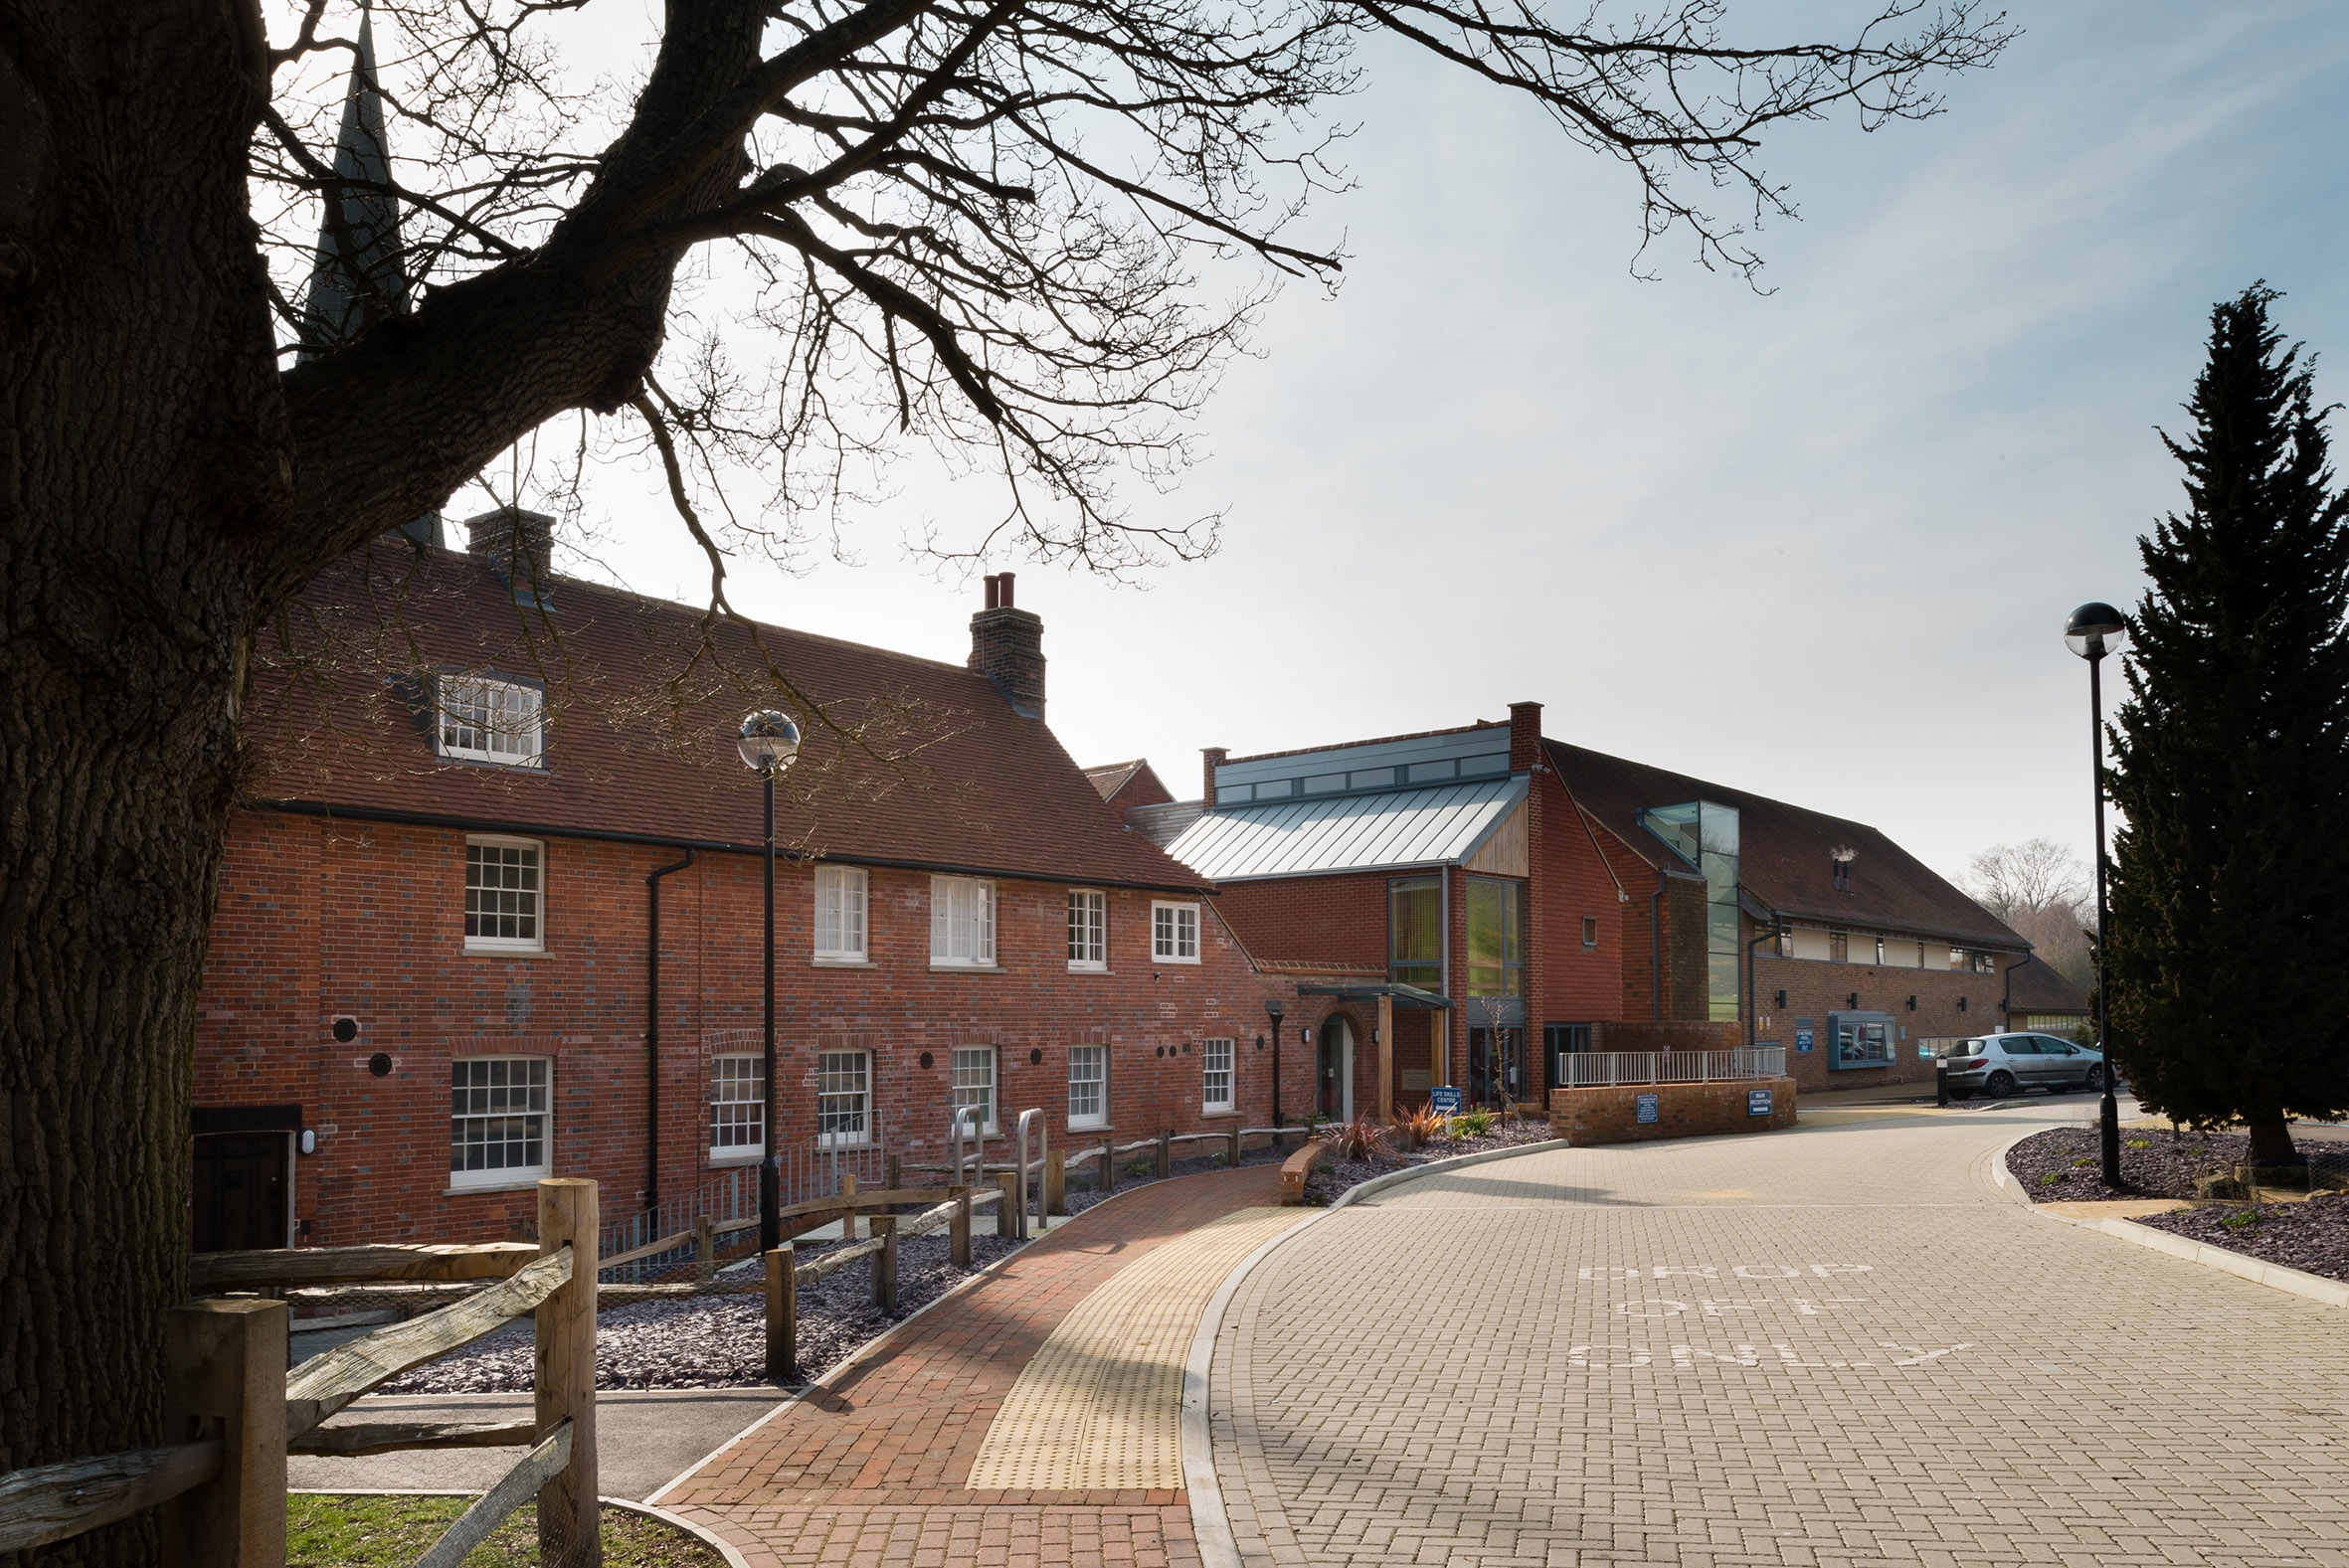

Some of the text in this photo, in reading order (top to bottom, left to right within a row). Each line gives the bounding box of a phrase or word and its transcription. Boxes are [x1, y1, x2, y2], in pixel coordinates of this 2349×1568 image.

[1577, 1264, 1875, 1281] DROP
[1615, 1299, 1869, 1317] OFF
[1566, 1342, 1976, 1369] ONLY
